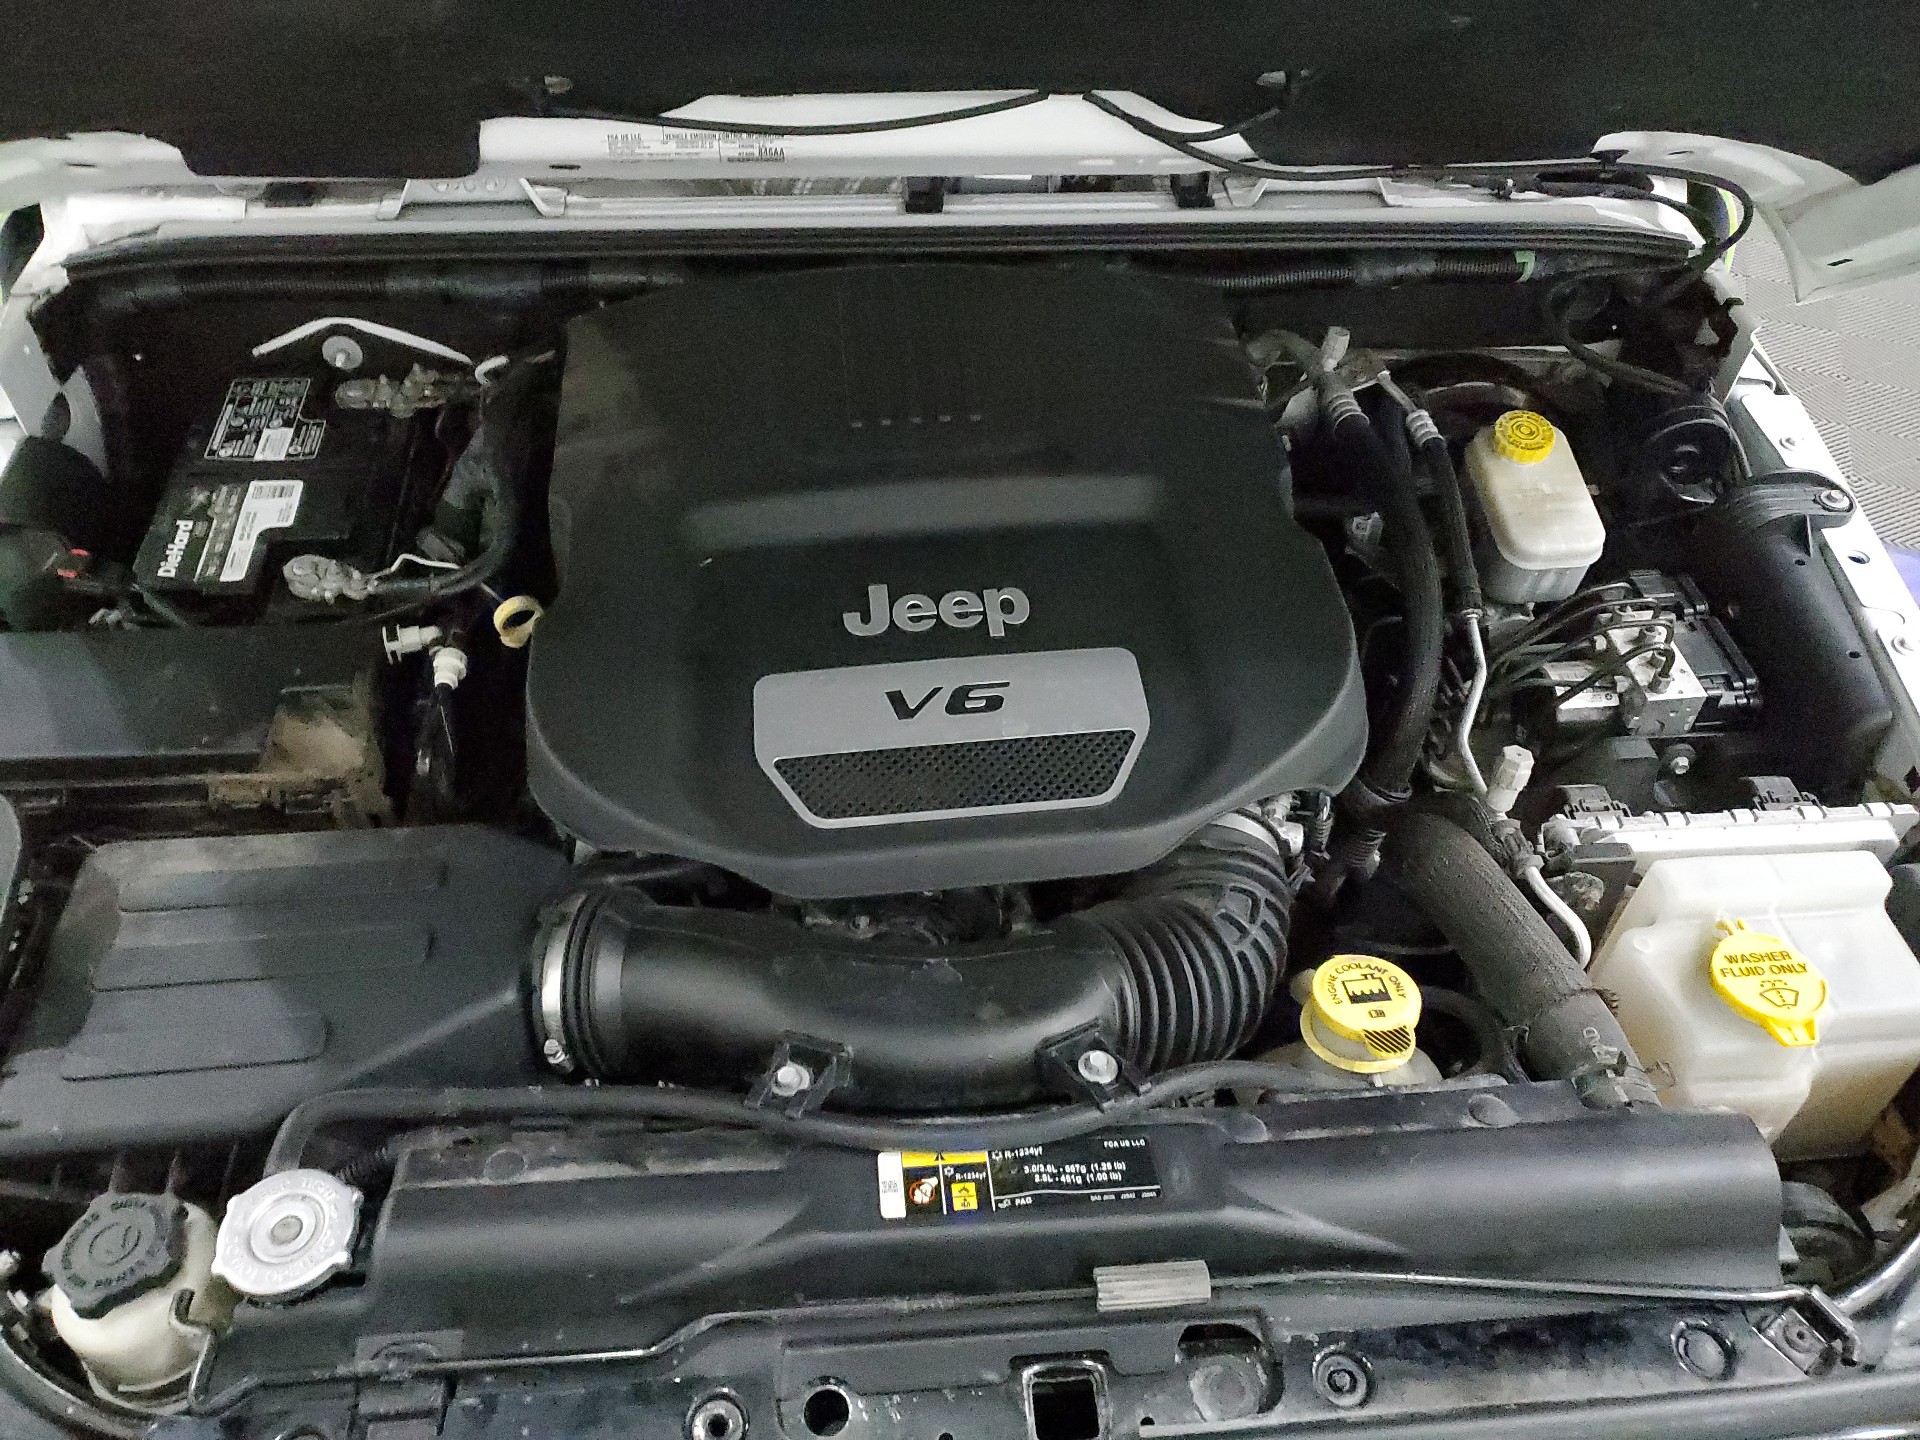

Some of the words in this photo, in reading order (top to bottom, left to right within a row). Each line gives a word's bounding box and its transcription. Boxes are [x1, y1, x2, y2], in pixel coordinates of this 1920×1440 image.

[157, 519, 193, 578] DieHard
[842, 583, 1030, 638] Jeep
[884, 681, 1011, 721] V6
[1720, 966, 1766, 978] FLUID
[1768, 962, 1809, 976] ONLY
[1723, 950, 1793, 965] WASHER
[1327, 974, 1343, 1005] ENGINE
[1335, 962, 1389, 975] COOLANT
[1388, 975, 1407, 999] ONLY
